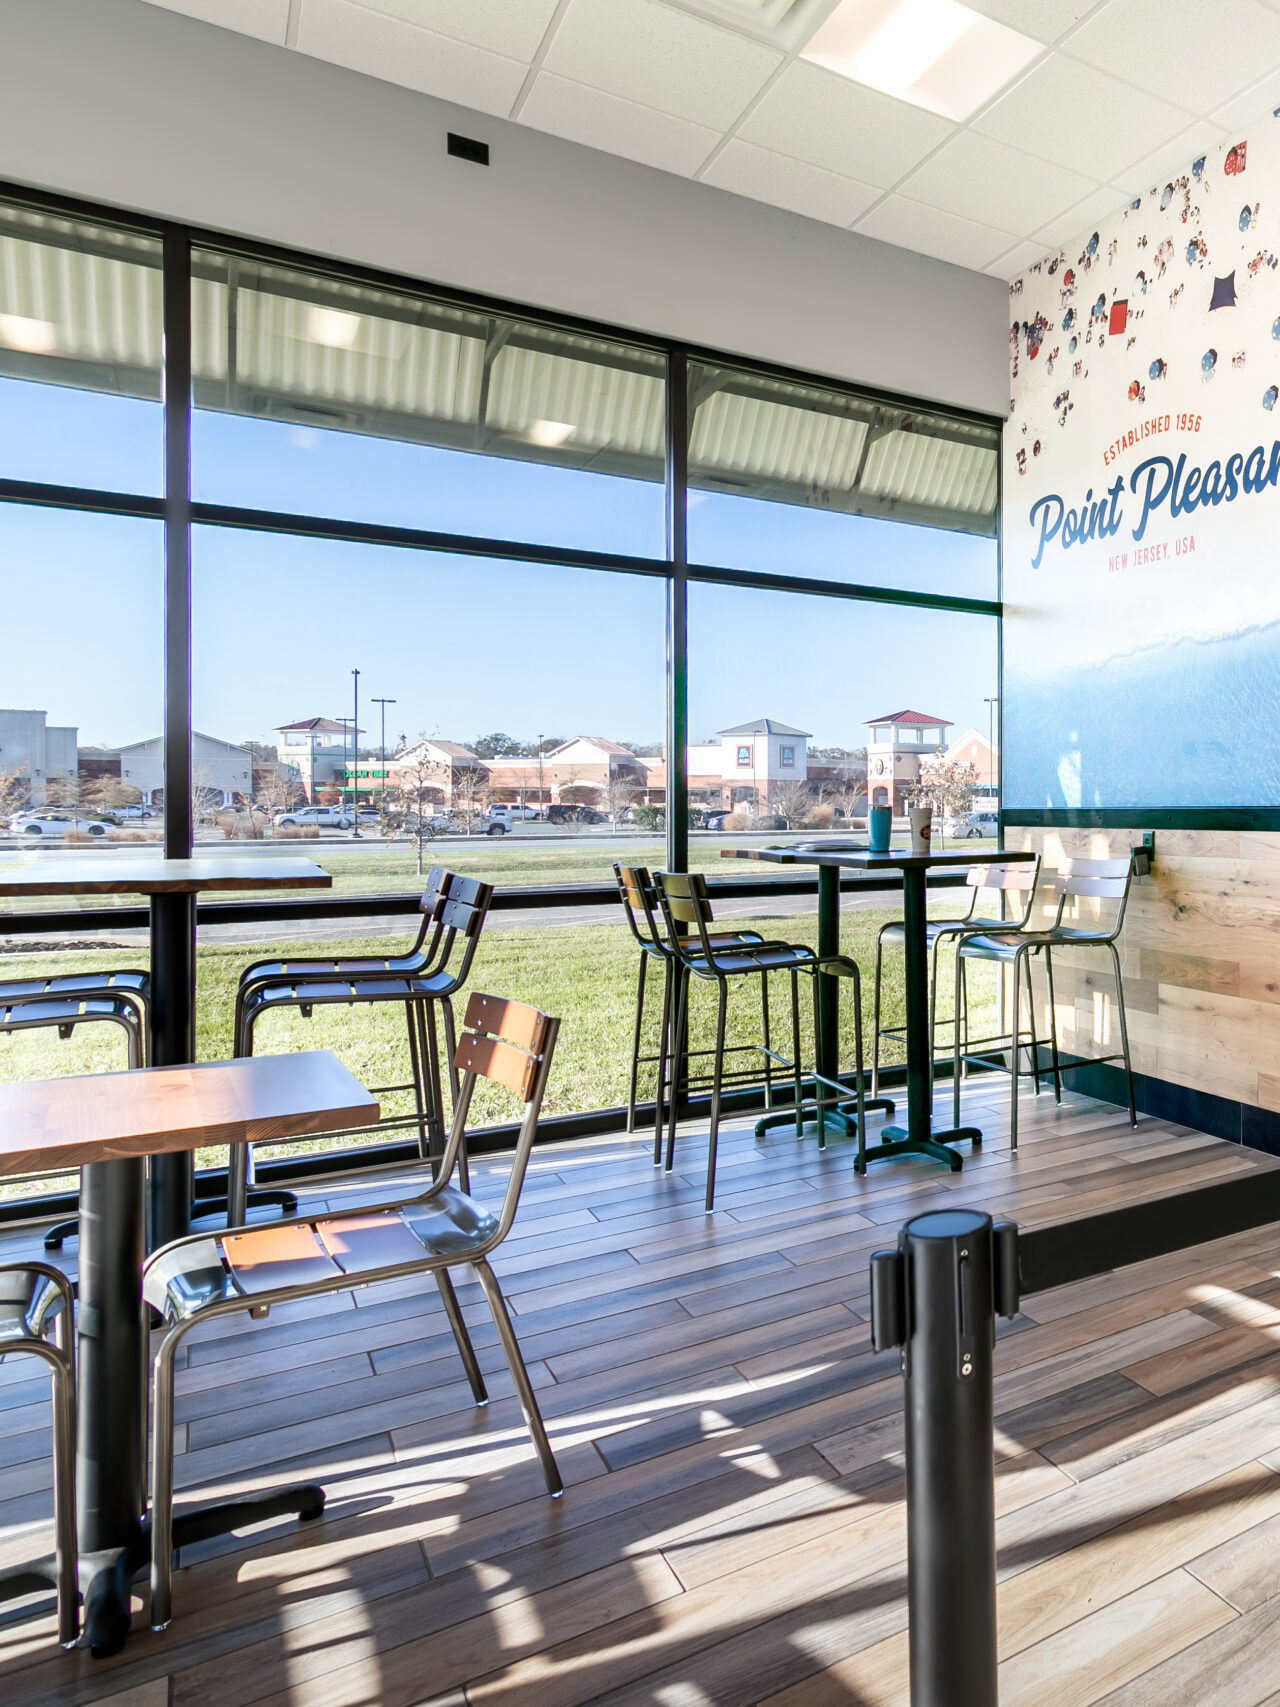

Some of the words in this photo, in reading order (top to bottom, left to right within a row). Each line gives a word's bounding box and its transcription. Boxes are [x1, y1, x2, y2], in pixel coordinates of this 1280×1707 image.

[1103, 414, 1170, 466] ESTABLISHED
[1176, 413, 1202, 432] 1956
[1029, 475, 1125, 570] Point
[1109, 552, 1128, 572] NEW
[1176, 535, 1195, 556] USA
